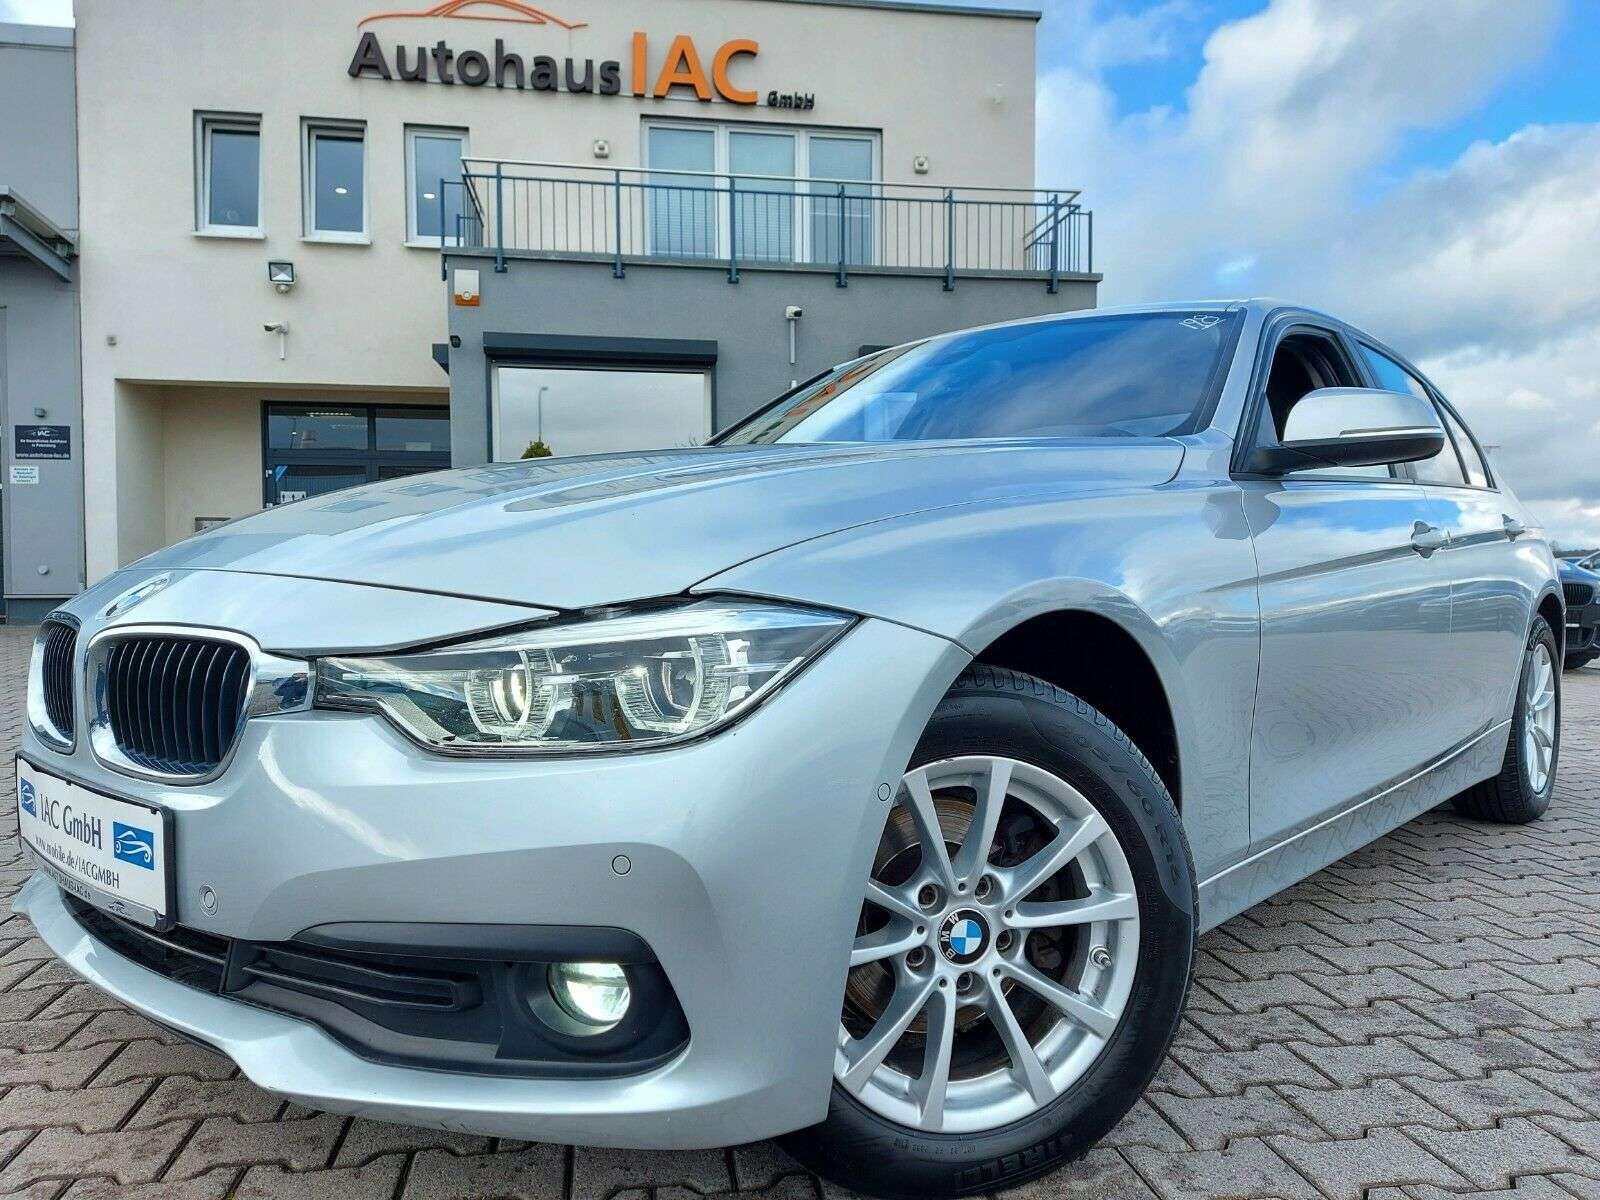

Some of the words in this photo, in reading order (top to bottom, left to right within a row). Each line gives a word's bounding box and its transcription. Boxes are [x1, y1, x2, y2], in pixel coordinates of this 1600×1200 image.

[347, 32, 620, 96] Autohaus
[631, 31, 760, 105] IAC
[768, 91, 815, 110] GmbH
[40, 794, 60, 830] IAC
[63, 805, 103, 851] GmbH
[940, 912, 960, 960] BMW
